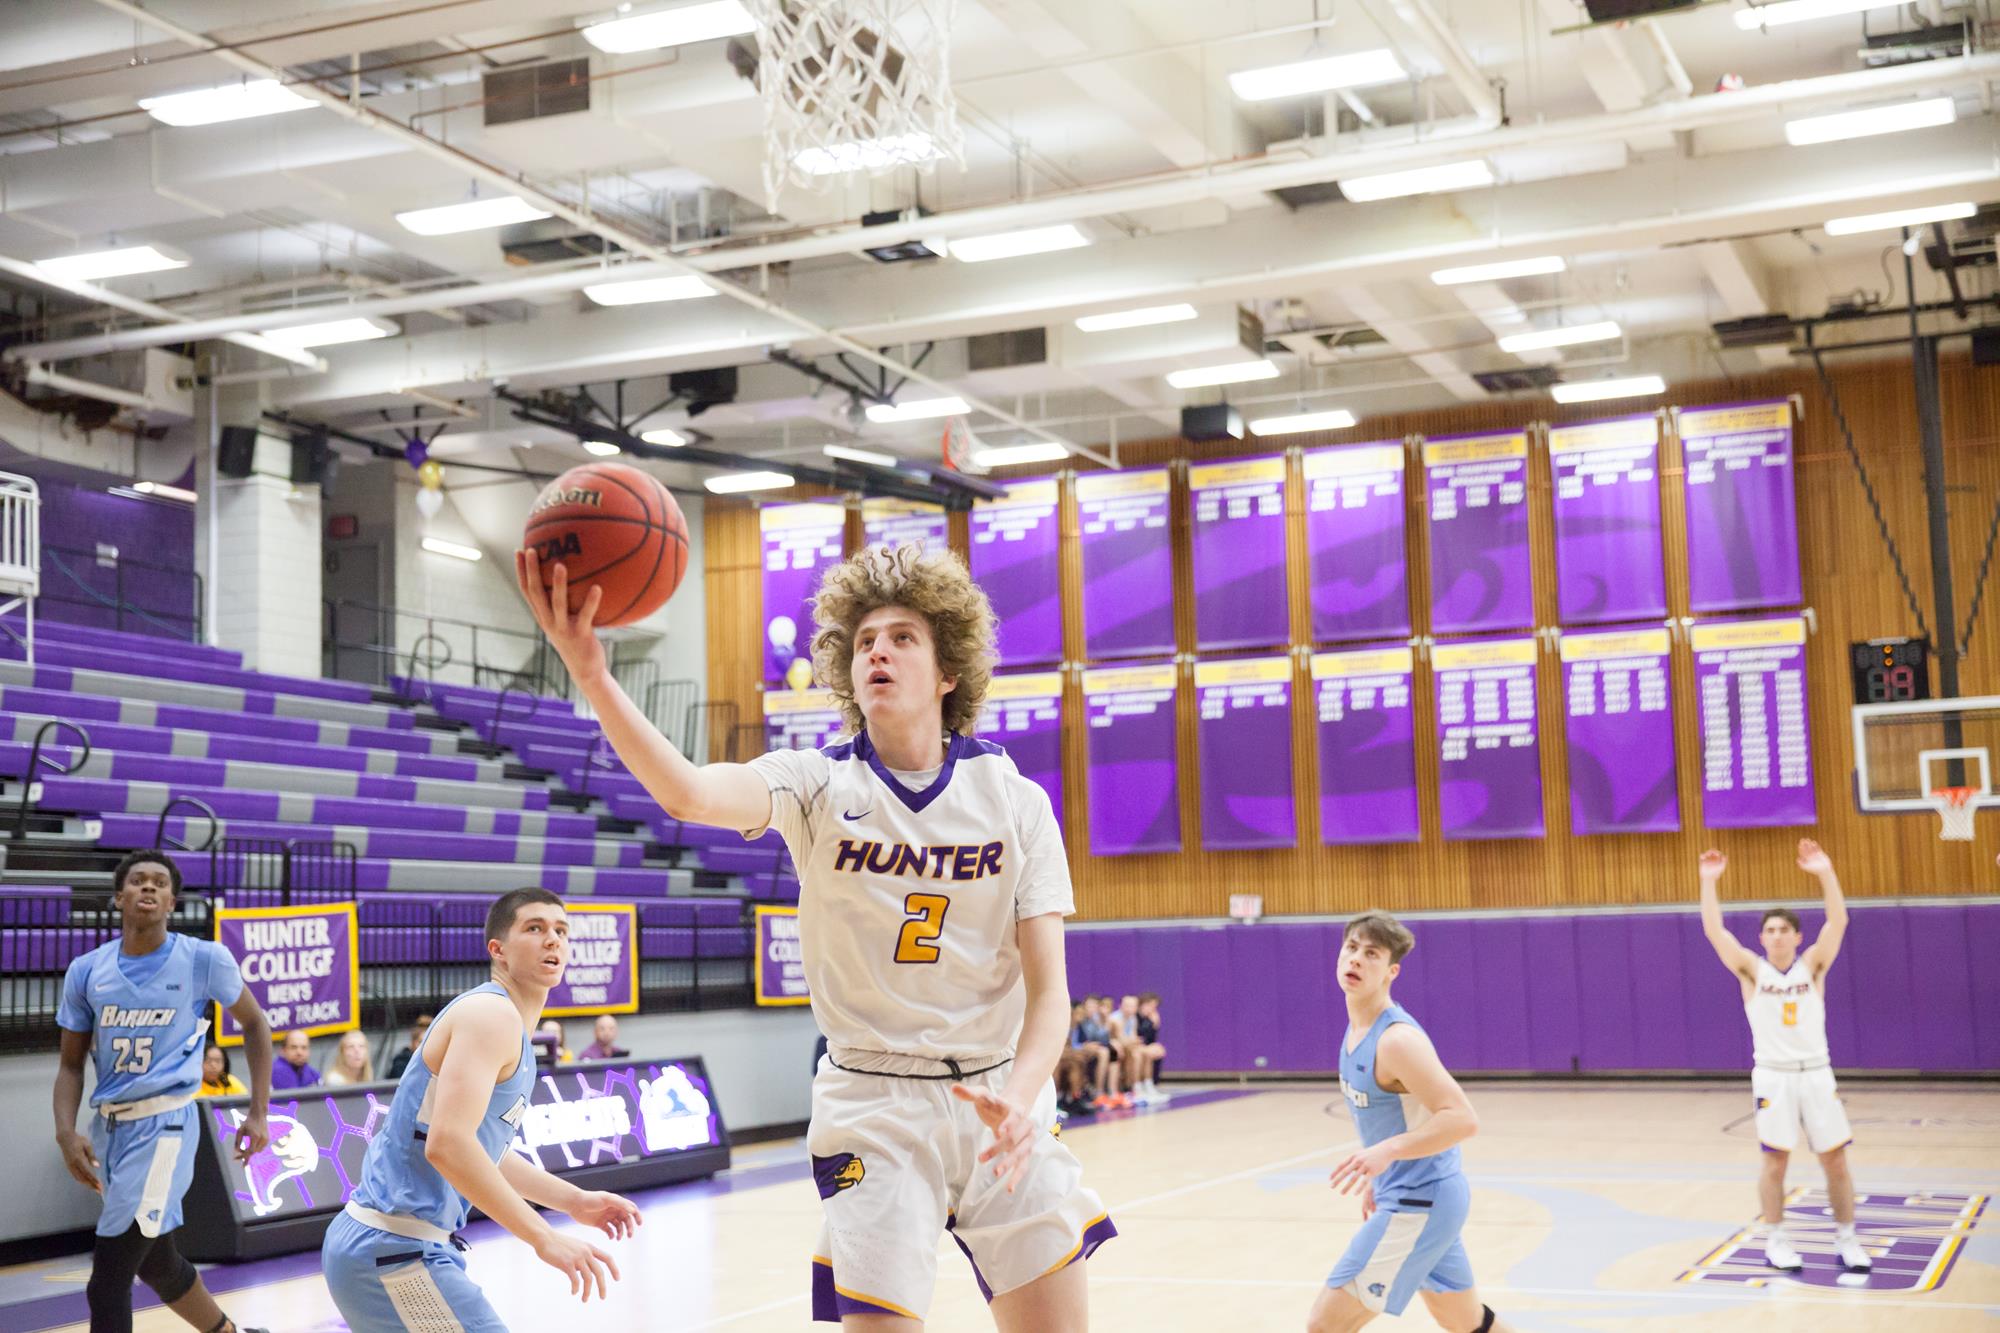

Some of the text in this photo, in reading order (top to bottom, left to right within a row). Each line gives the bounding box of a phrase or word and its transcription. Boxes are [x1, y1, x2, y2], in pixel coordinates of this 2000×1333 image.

[535, 532, 581, 561] CAA
[833, 839, 1004, 881] HUNTER
[243, 917, 331, 951] HUNTER
[567, 914, 619, 939] UNTER
[893, 892, 950, 963] 2
[240, 947, 335, 983] COLLEGE
[568, 940, 623, 967] OLLEGE
[267, 981, 312, 1004] MEN'S
[101, 1005, 177, 1029] BARUCH
[295, 1000, 341, 1024] TRACK
[112, 1036, 154, 1075] 25
